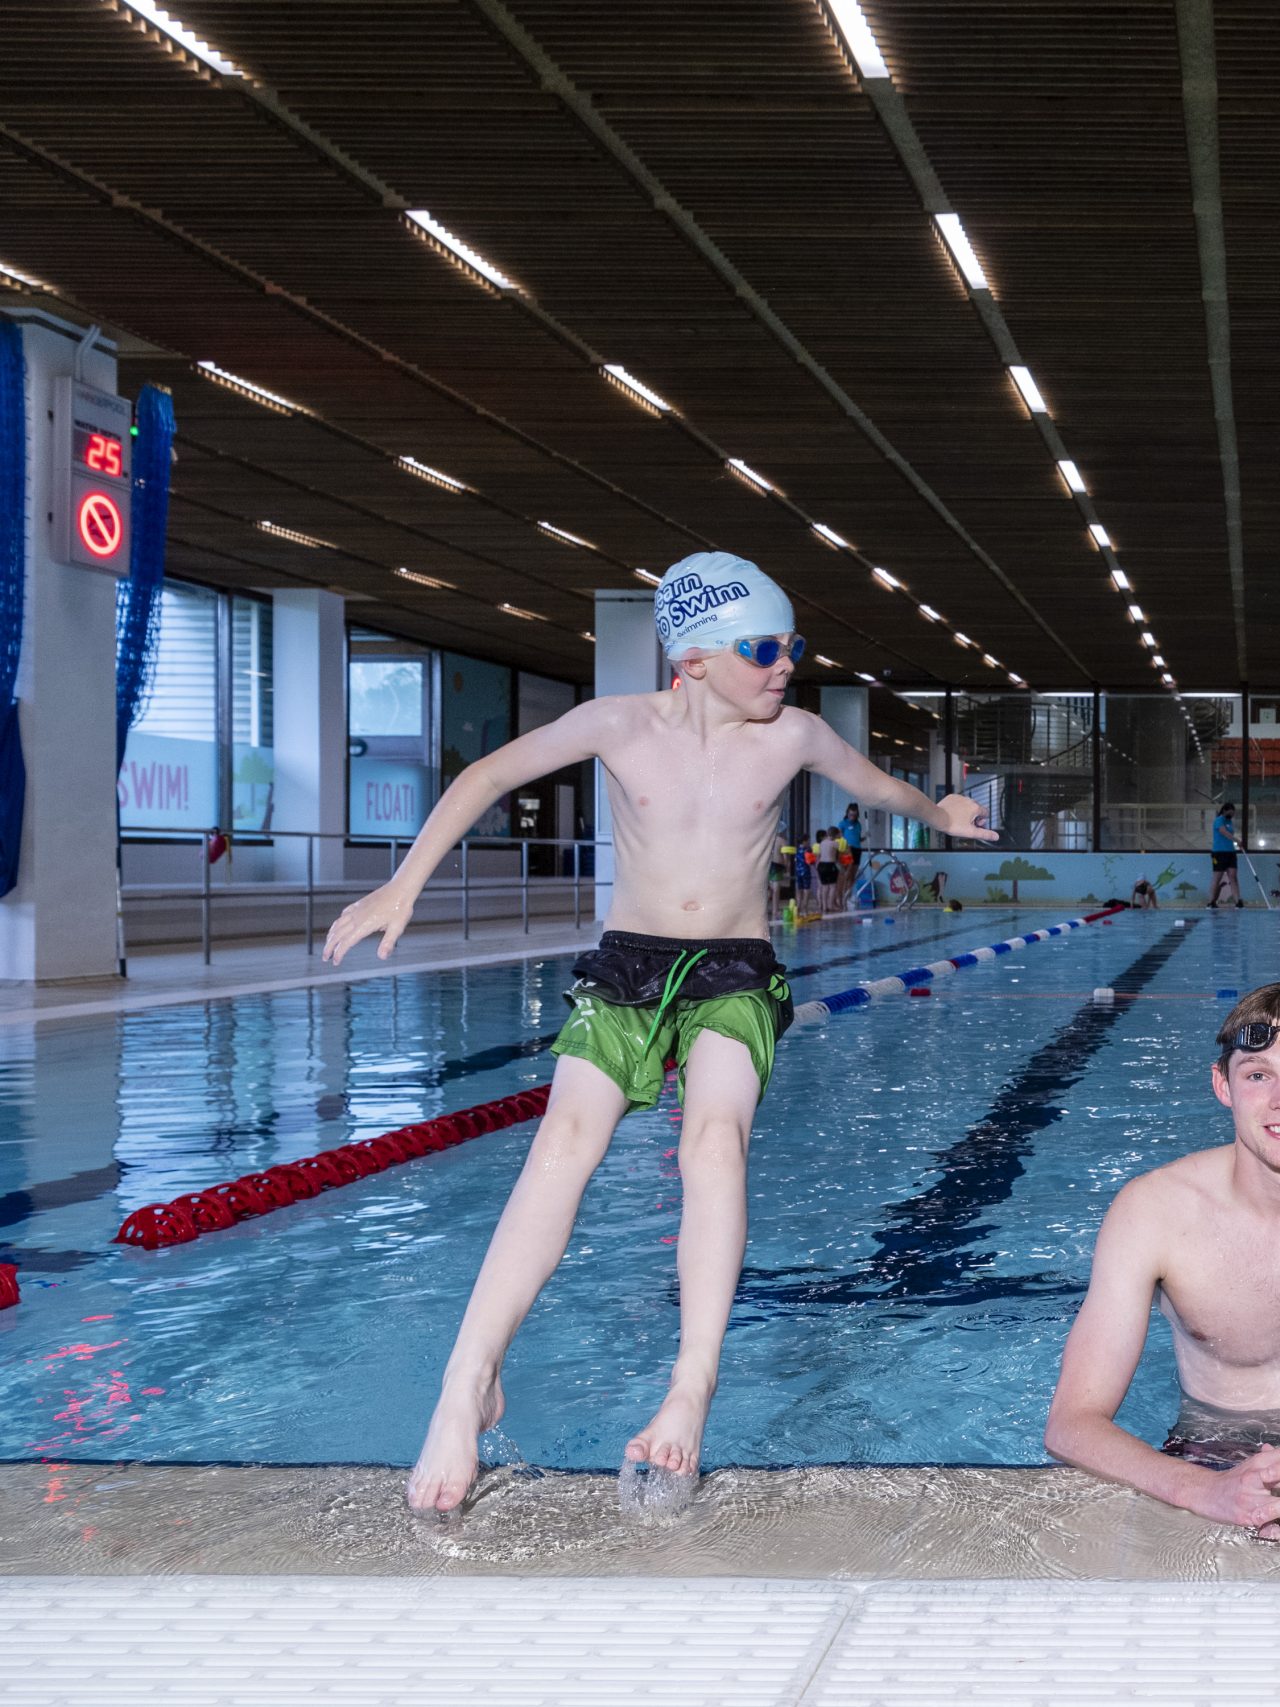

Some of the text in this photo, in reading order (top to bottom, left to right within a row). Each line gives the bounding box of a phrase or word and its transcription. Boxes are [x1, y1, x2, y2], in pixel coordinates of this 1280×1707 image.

[87, 434, 121, 476] 25
[655, 581, 750, 640] o Swim
[366, 782, 415, 822] FLOAT!
